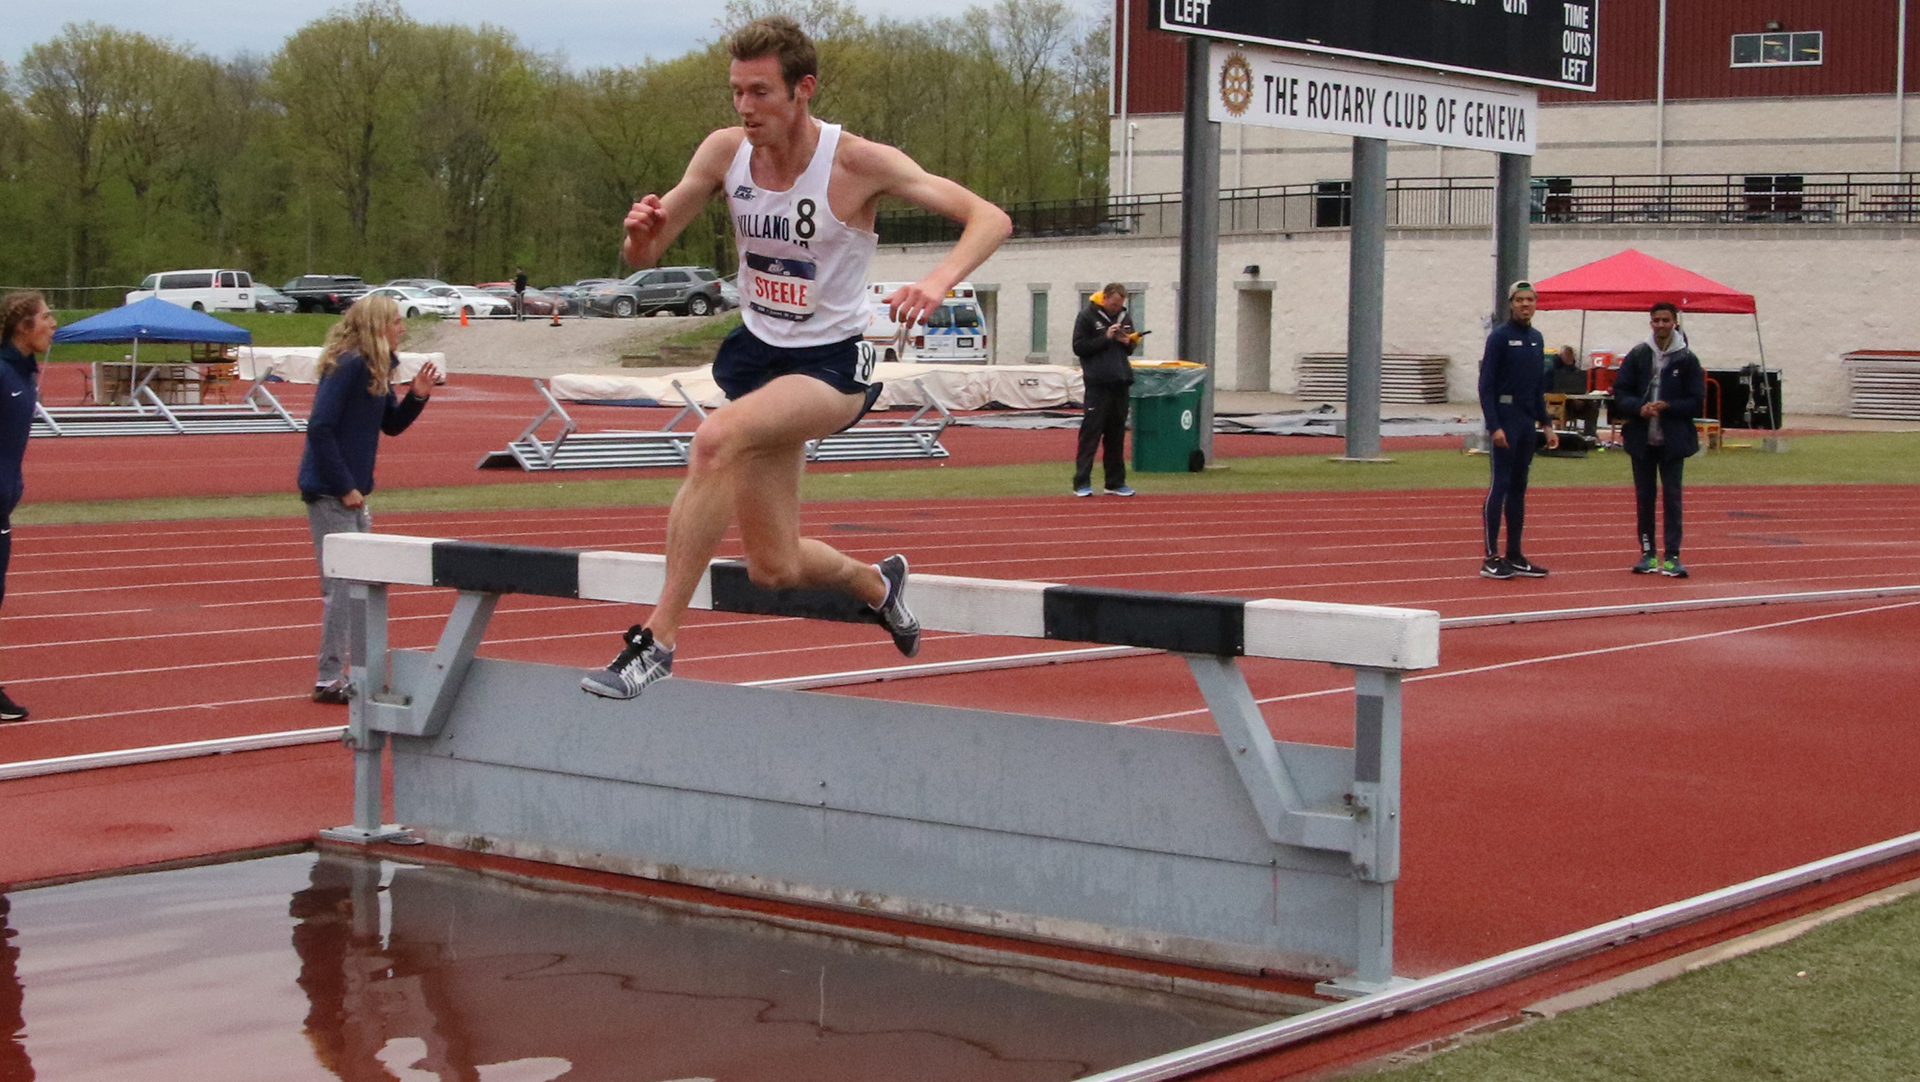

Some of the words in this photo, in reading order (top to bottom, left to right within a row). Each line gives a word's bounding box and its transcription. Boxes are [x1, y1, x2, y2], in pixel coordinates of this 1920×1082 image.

[1174, 0, 1211, 25] LEFT
[1563, 3, 1590, 29] TIME
[1562, 30, 1591, 57] OUTS
[1561, 57, 1588, 83] LEFT
[1264, 75, 1299, 117] THE
[1307, 80, 1376, 125] ROTARY
[1383, 90, 1428, 131] CLUB
[1436, 97, 1457, 134] OF
[1464, 101, 1526, 143] GENEVA
[737, 214, 809, 250] VILLANO
[795, 198, 817, 240] 8
[755, 276, 808, 307] STEELE
[861, 342, 871, 382] 8
[1594, 357, 1604, 367] G
